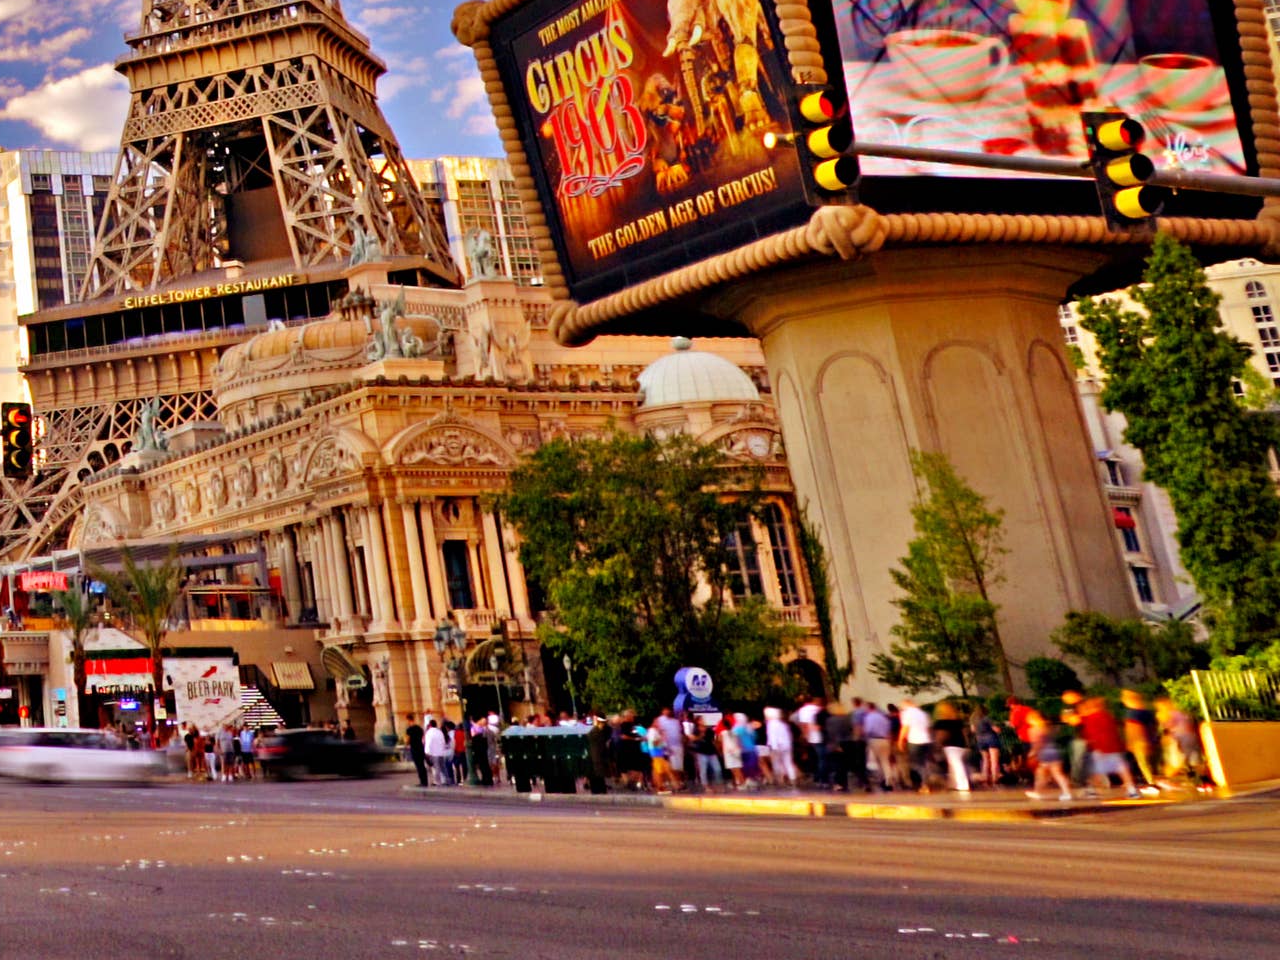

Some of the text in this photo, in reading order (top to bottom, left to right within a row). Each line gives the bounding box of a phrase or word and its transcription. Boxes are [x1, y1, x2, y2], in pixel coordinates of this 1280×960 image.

[538, 22, 558, 47] THE
[556, 8, 582, 37] MOST
[526, 20, 634, 121] CIRCUS
[548, 73, 647, 196] 1903
[587, 166, 779, 260] THE GOLDEN AGE OF CIRCUS!
[124, 273, 294, 309] EIFFEL TOWER RESTAURANT
[187, 680, 236, 701] BEER PARK
